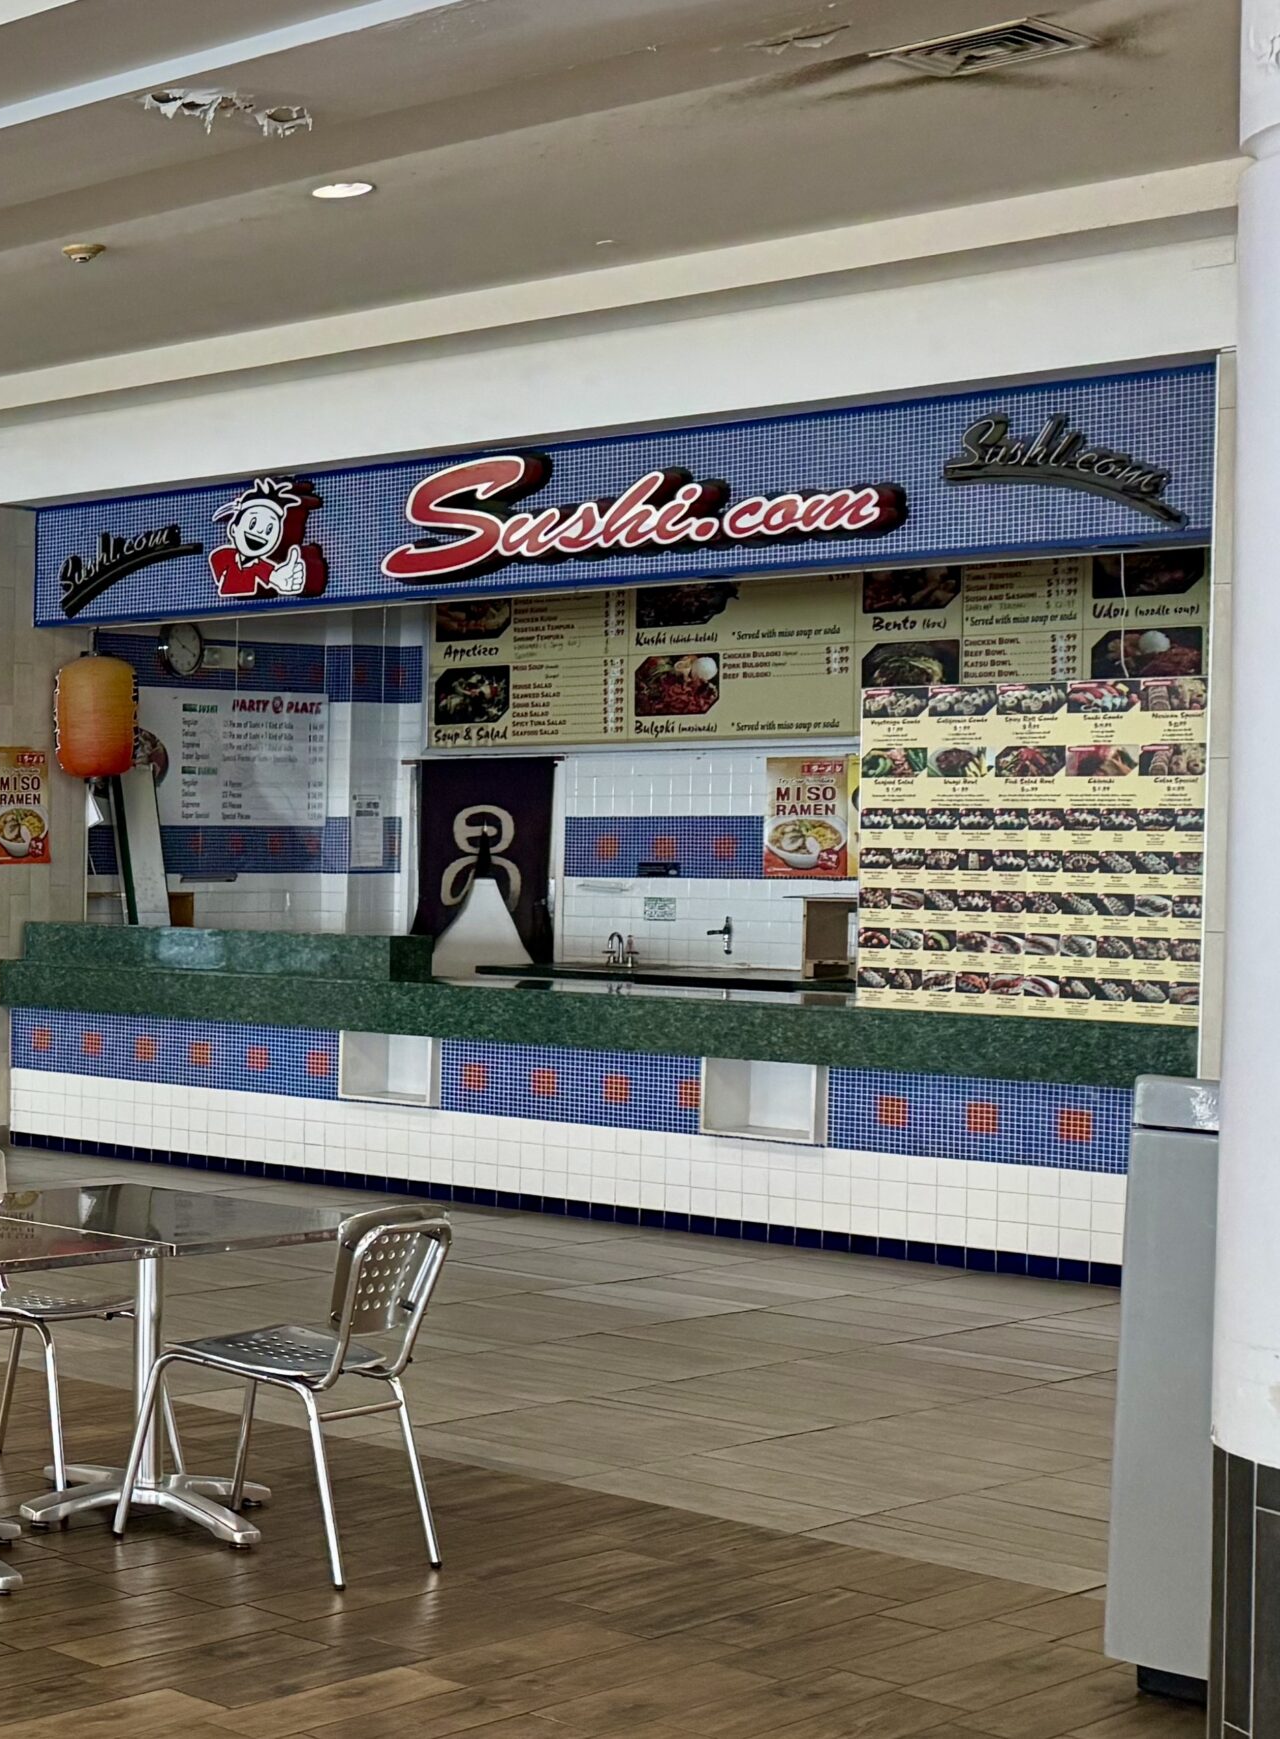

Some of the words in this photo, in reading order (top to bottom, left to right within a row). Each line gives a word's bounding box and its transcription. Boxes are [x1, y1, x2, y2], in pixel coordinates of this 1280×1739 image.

[945, 413, 1169, 497] Sushi.com
[381, 455, 883, 579] Sushi.com
[58, 525, 177, 597] Sushi.com
[1092, 601, 1129, 619] Udon
[872, 616, 917, 631] Bento
[635, 631, 667, 647] Kushi
[736, 629, 760, 641] Served
[761, 629, 777, 639] with
[778, 628, 794, 638] miso
[796, 629, 813, 640] soup
[823, 625, 841, 636] soda
[443, 644, 500, 661] Appetizer
[985, 648, 1007, 656] BOWL
[964, 660, 989, 668] KATSU
[722, 672, 739, 680] BEEF
[232, 699, 270, 712] PARTY
[286, 701, 323, 714] PLATE
[736, 721, 759, 732] Served
[760, 720, 776, 730] with
[777, 720, 794, 729] miso
[795, 721, 812, 732] soup
[823, 717, 840, 728] soda
[434, 730, 460, 744] Soup
[463, 728, 473, 741] &
[476, 726, 508, 741] Salad
[0, 776, 41, 791] MISO
[0, 793, 41, 805] RAMEN
[776, 786, 837, 801] MISO
[776, 803, 836, 816] RAMEN
